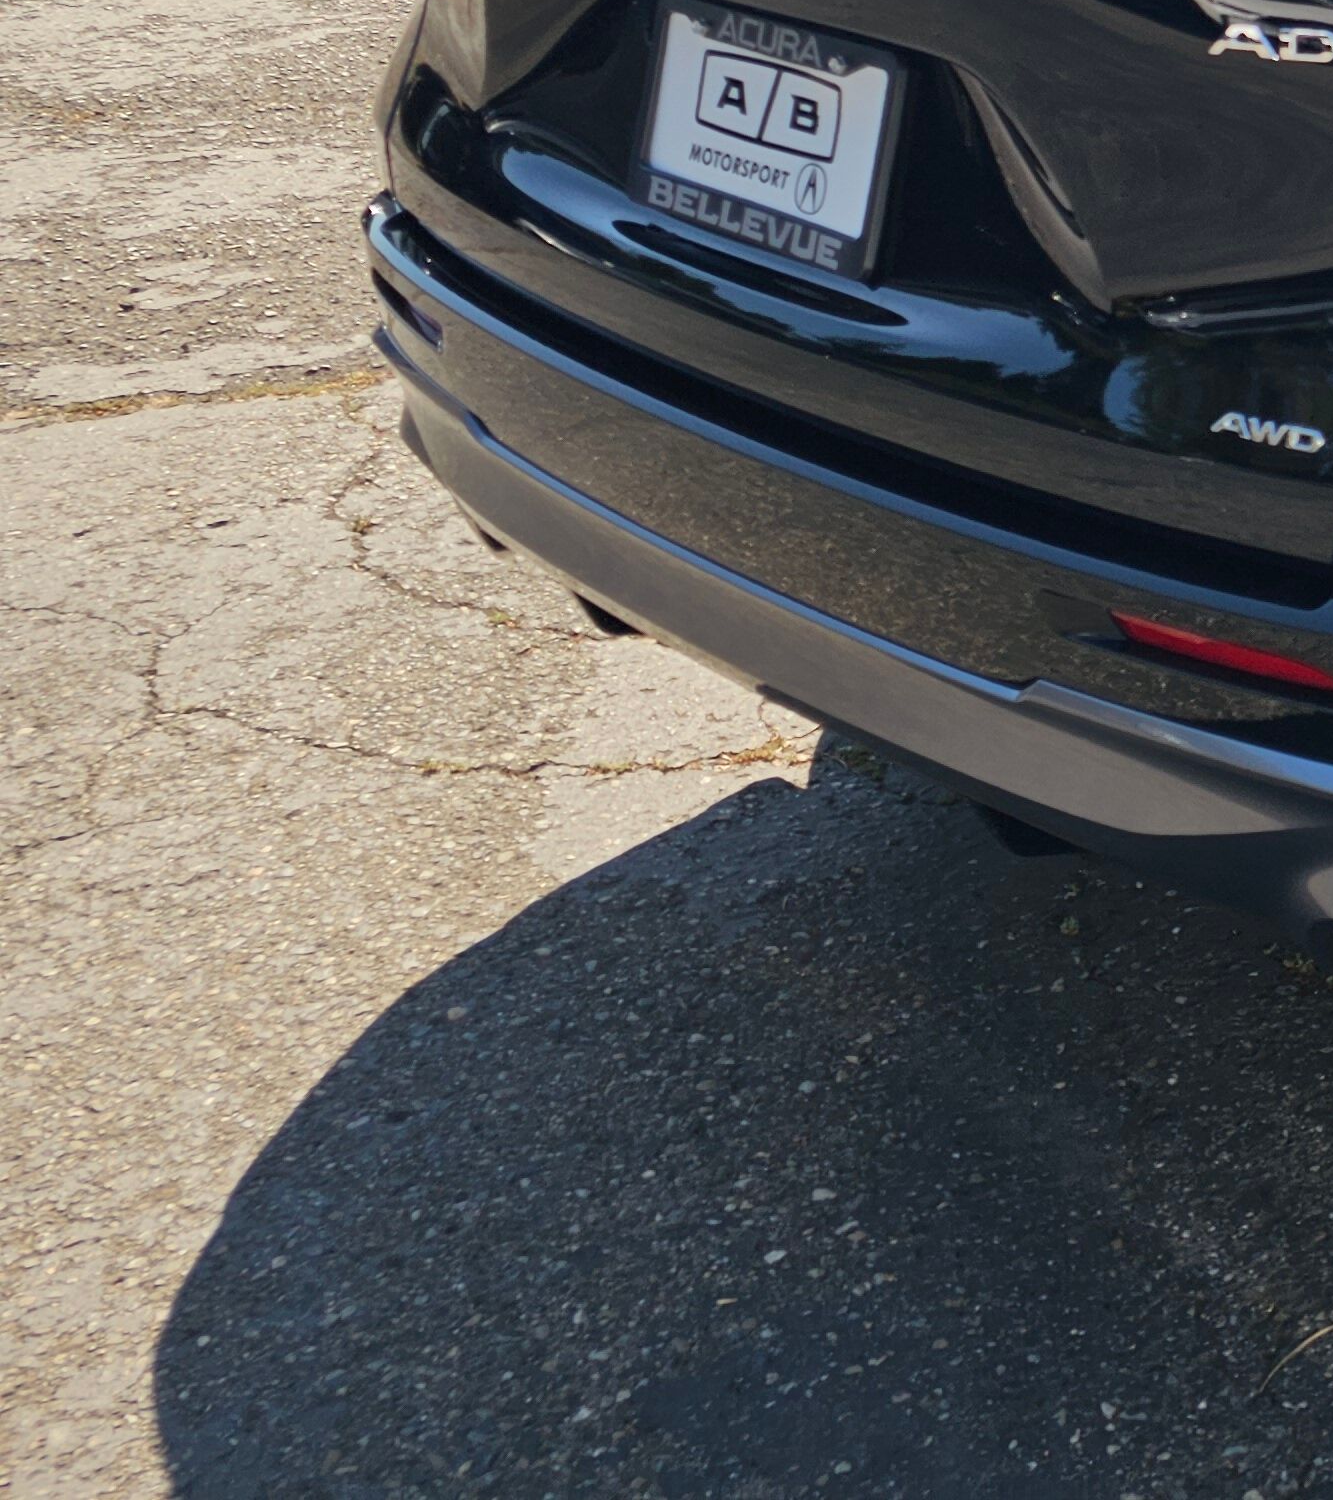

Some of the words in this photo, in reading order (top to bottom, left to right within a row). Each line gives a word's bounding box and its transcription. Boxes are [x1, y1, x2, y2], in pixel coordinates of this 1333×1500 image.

[716, 14, 822, 69] ACURA
[688, 142, 790, 190] MOTORSPORT
[647, 175, 844, 271] BELLEVUE
[1209, 411, 1327, 454] AWD
